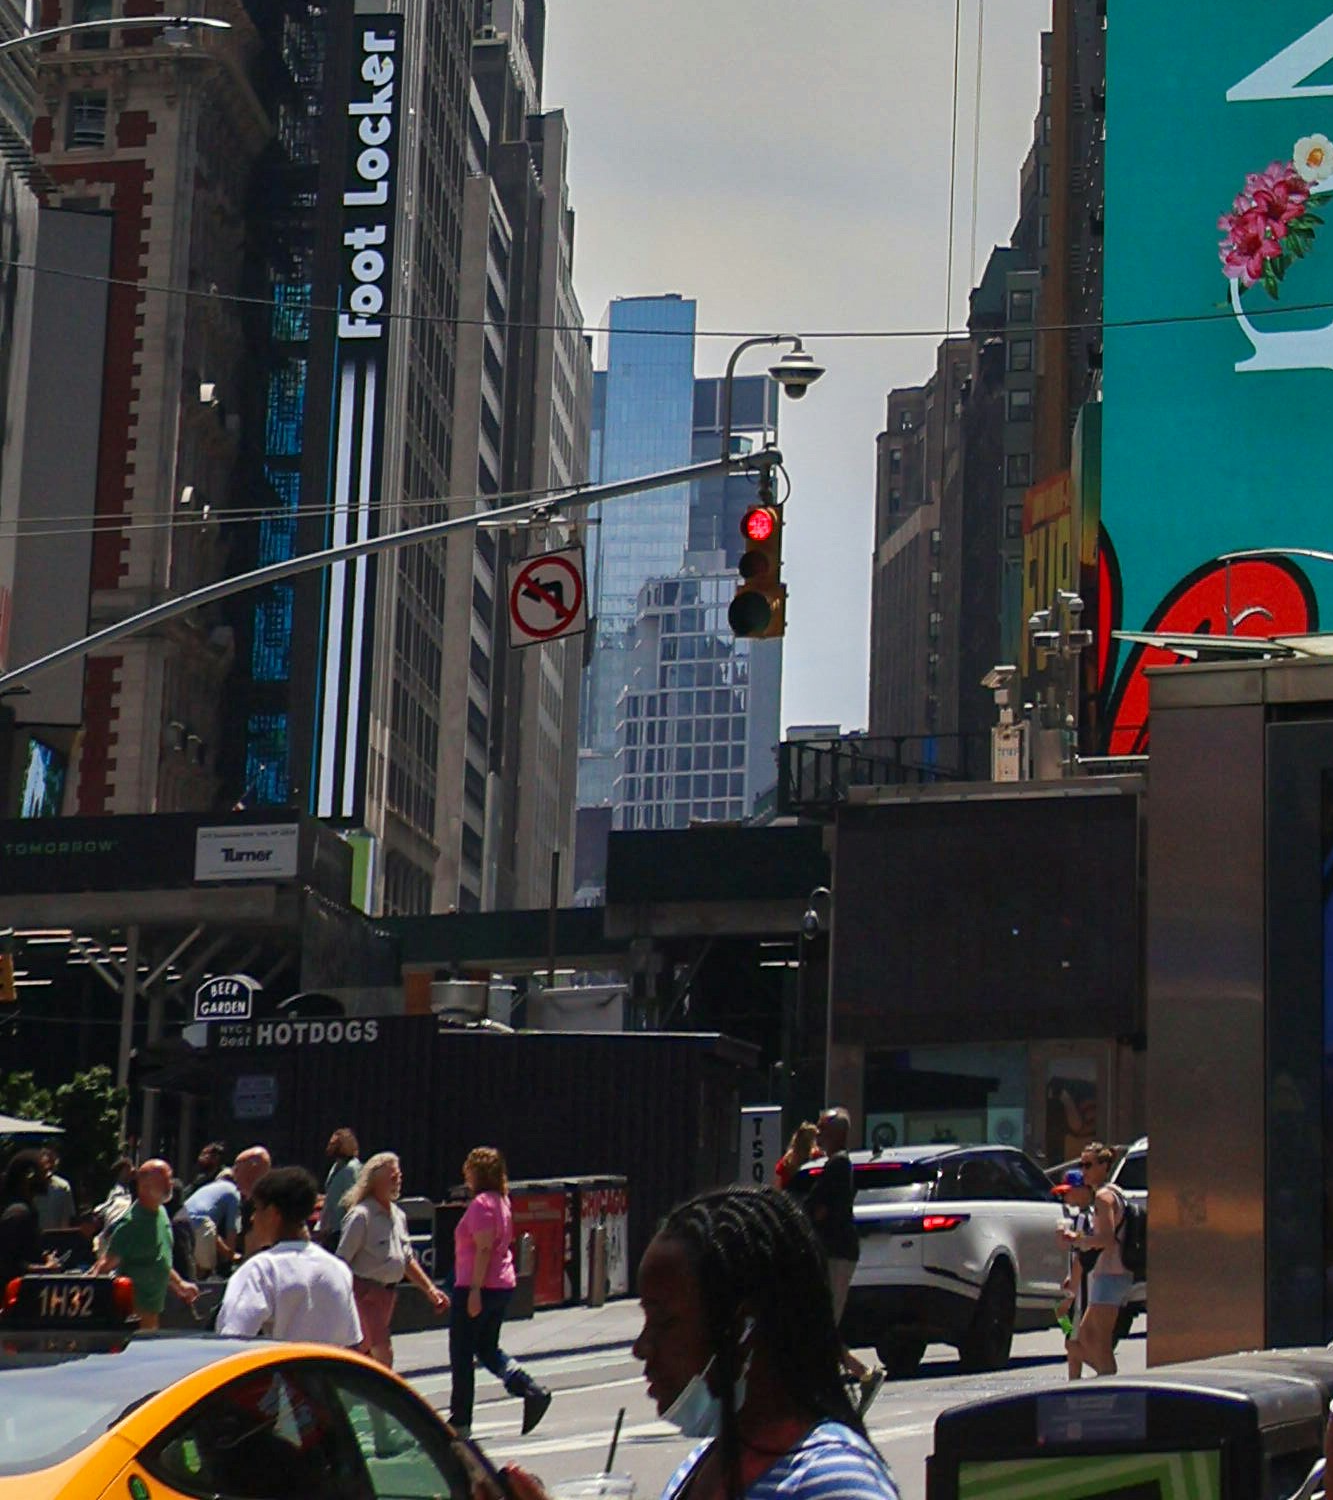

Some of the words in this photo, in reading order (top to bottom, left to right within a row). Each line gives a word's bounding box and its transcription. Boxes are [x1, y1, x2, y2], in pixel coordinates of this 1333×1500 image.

[343, 29, 398, 206] Locker
[339, 225, 387, 341] Foot
[221, 848, 272, 863] Turner
[211, 980, 239, 998] BEER
[200, 1000, 247, 1017] GARDEN
[256, 1020, 379, 1046] HOTDOGS
[38, 1285, 95, 1318] 1H32
